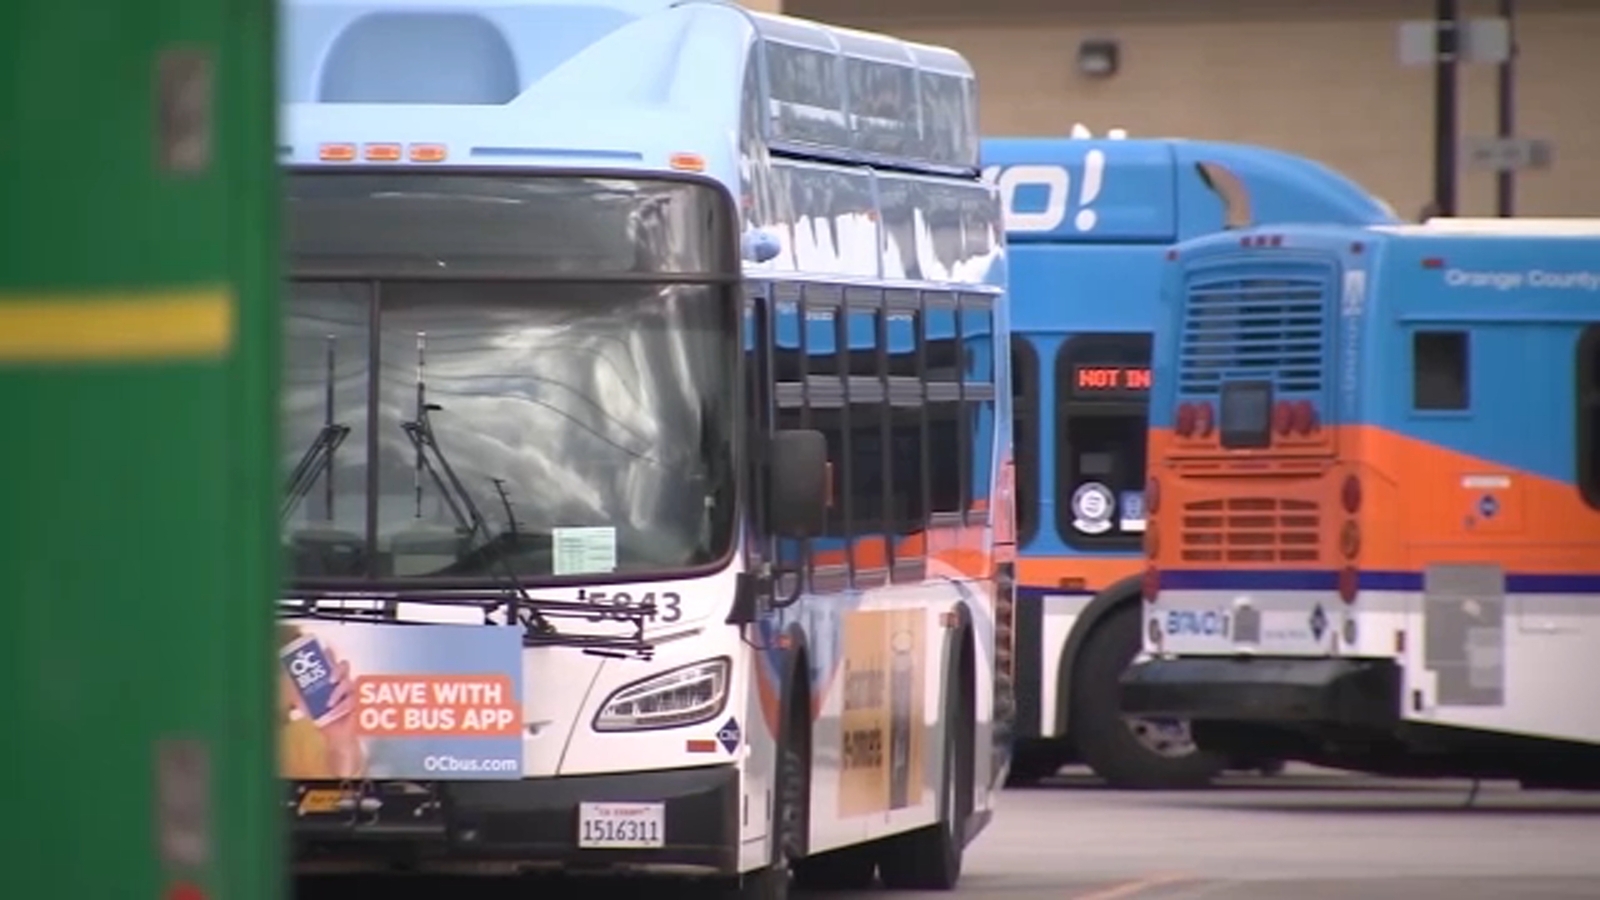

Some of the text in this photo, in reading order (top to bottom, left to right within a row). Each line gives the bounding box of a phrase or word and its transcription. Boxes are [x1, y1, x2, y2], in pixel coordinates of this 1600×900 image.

[1079, 369, 1151, 388] NOT IN
[588, 592, 682, 622] 5843
[290, 651, 321, 676] OC
[359, 682, 502, 705] SAVE WITH
[359, 708, 515, 731] OC BUS APP
[424, 755, 518, 772] OCbus.com
[583, 819, 660, 841] 1516311
